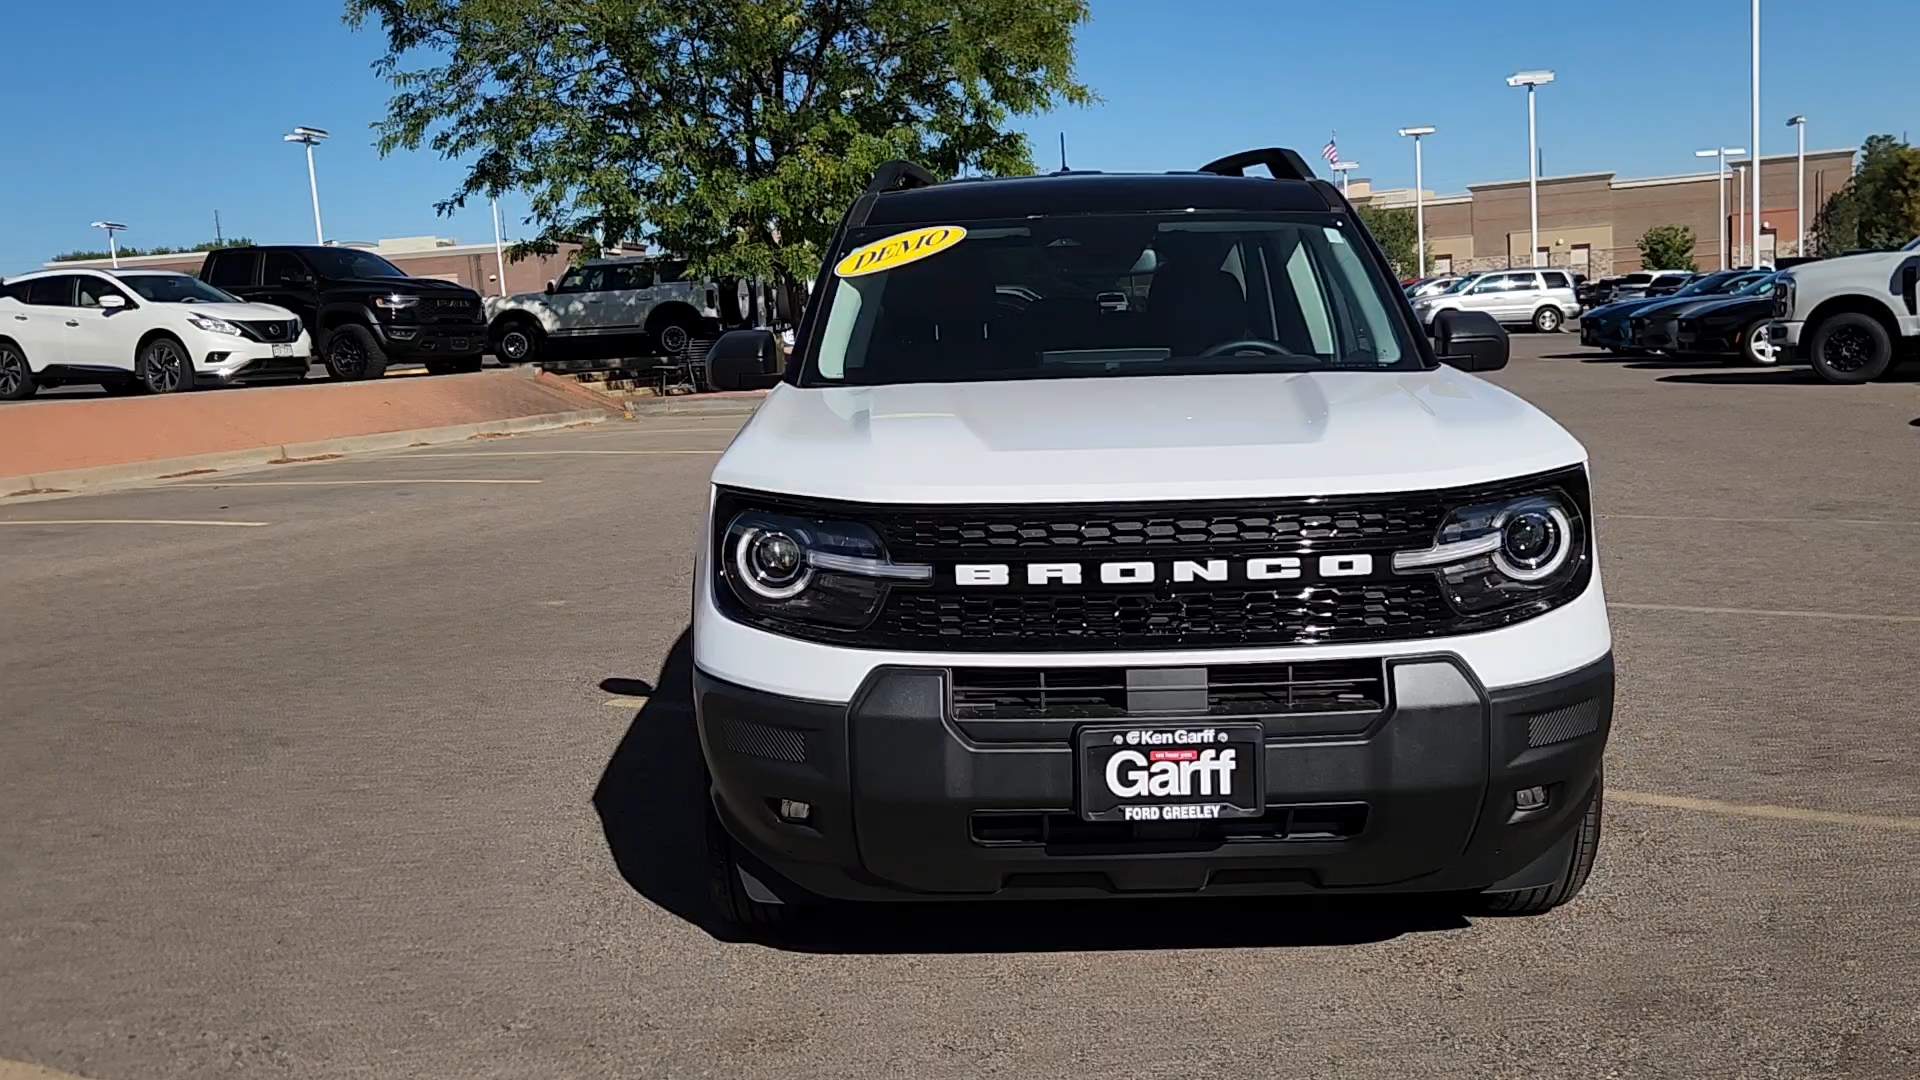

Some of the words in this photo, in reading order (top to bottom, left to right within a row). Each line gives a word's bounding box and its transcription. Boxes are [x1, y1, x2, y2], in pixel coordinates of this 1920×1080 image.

[853, 229, 949, 271] DEMO
[955, 554, 1373, 586] BRONCO
[1141, 730, 1173, 745] Ken
[1174, 728, 1215, 744] Garff
[1105, 749, 1236, 798] Garff
[1125, 807, 1160, 820] FORD
[1162, 805, 1220, 819] GREELEY
